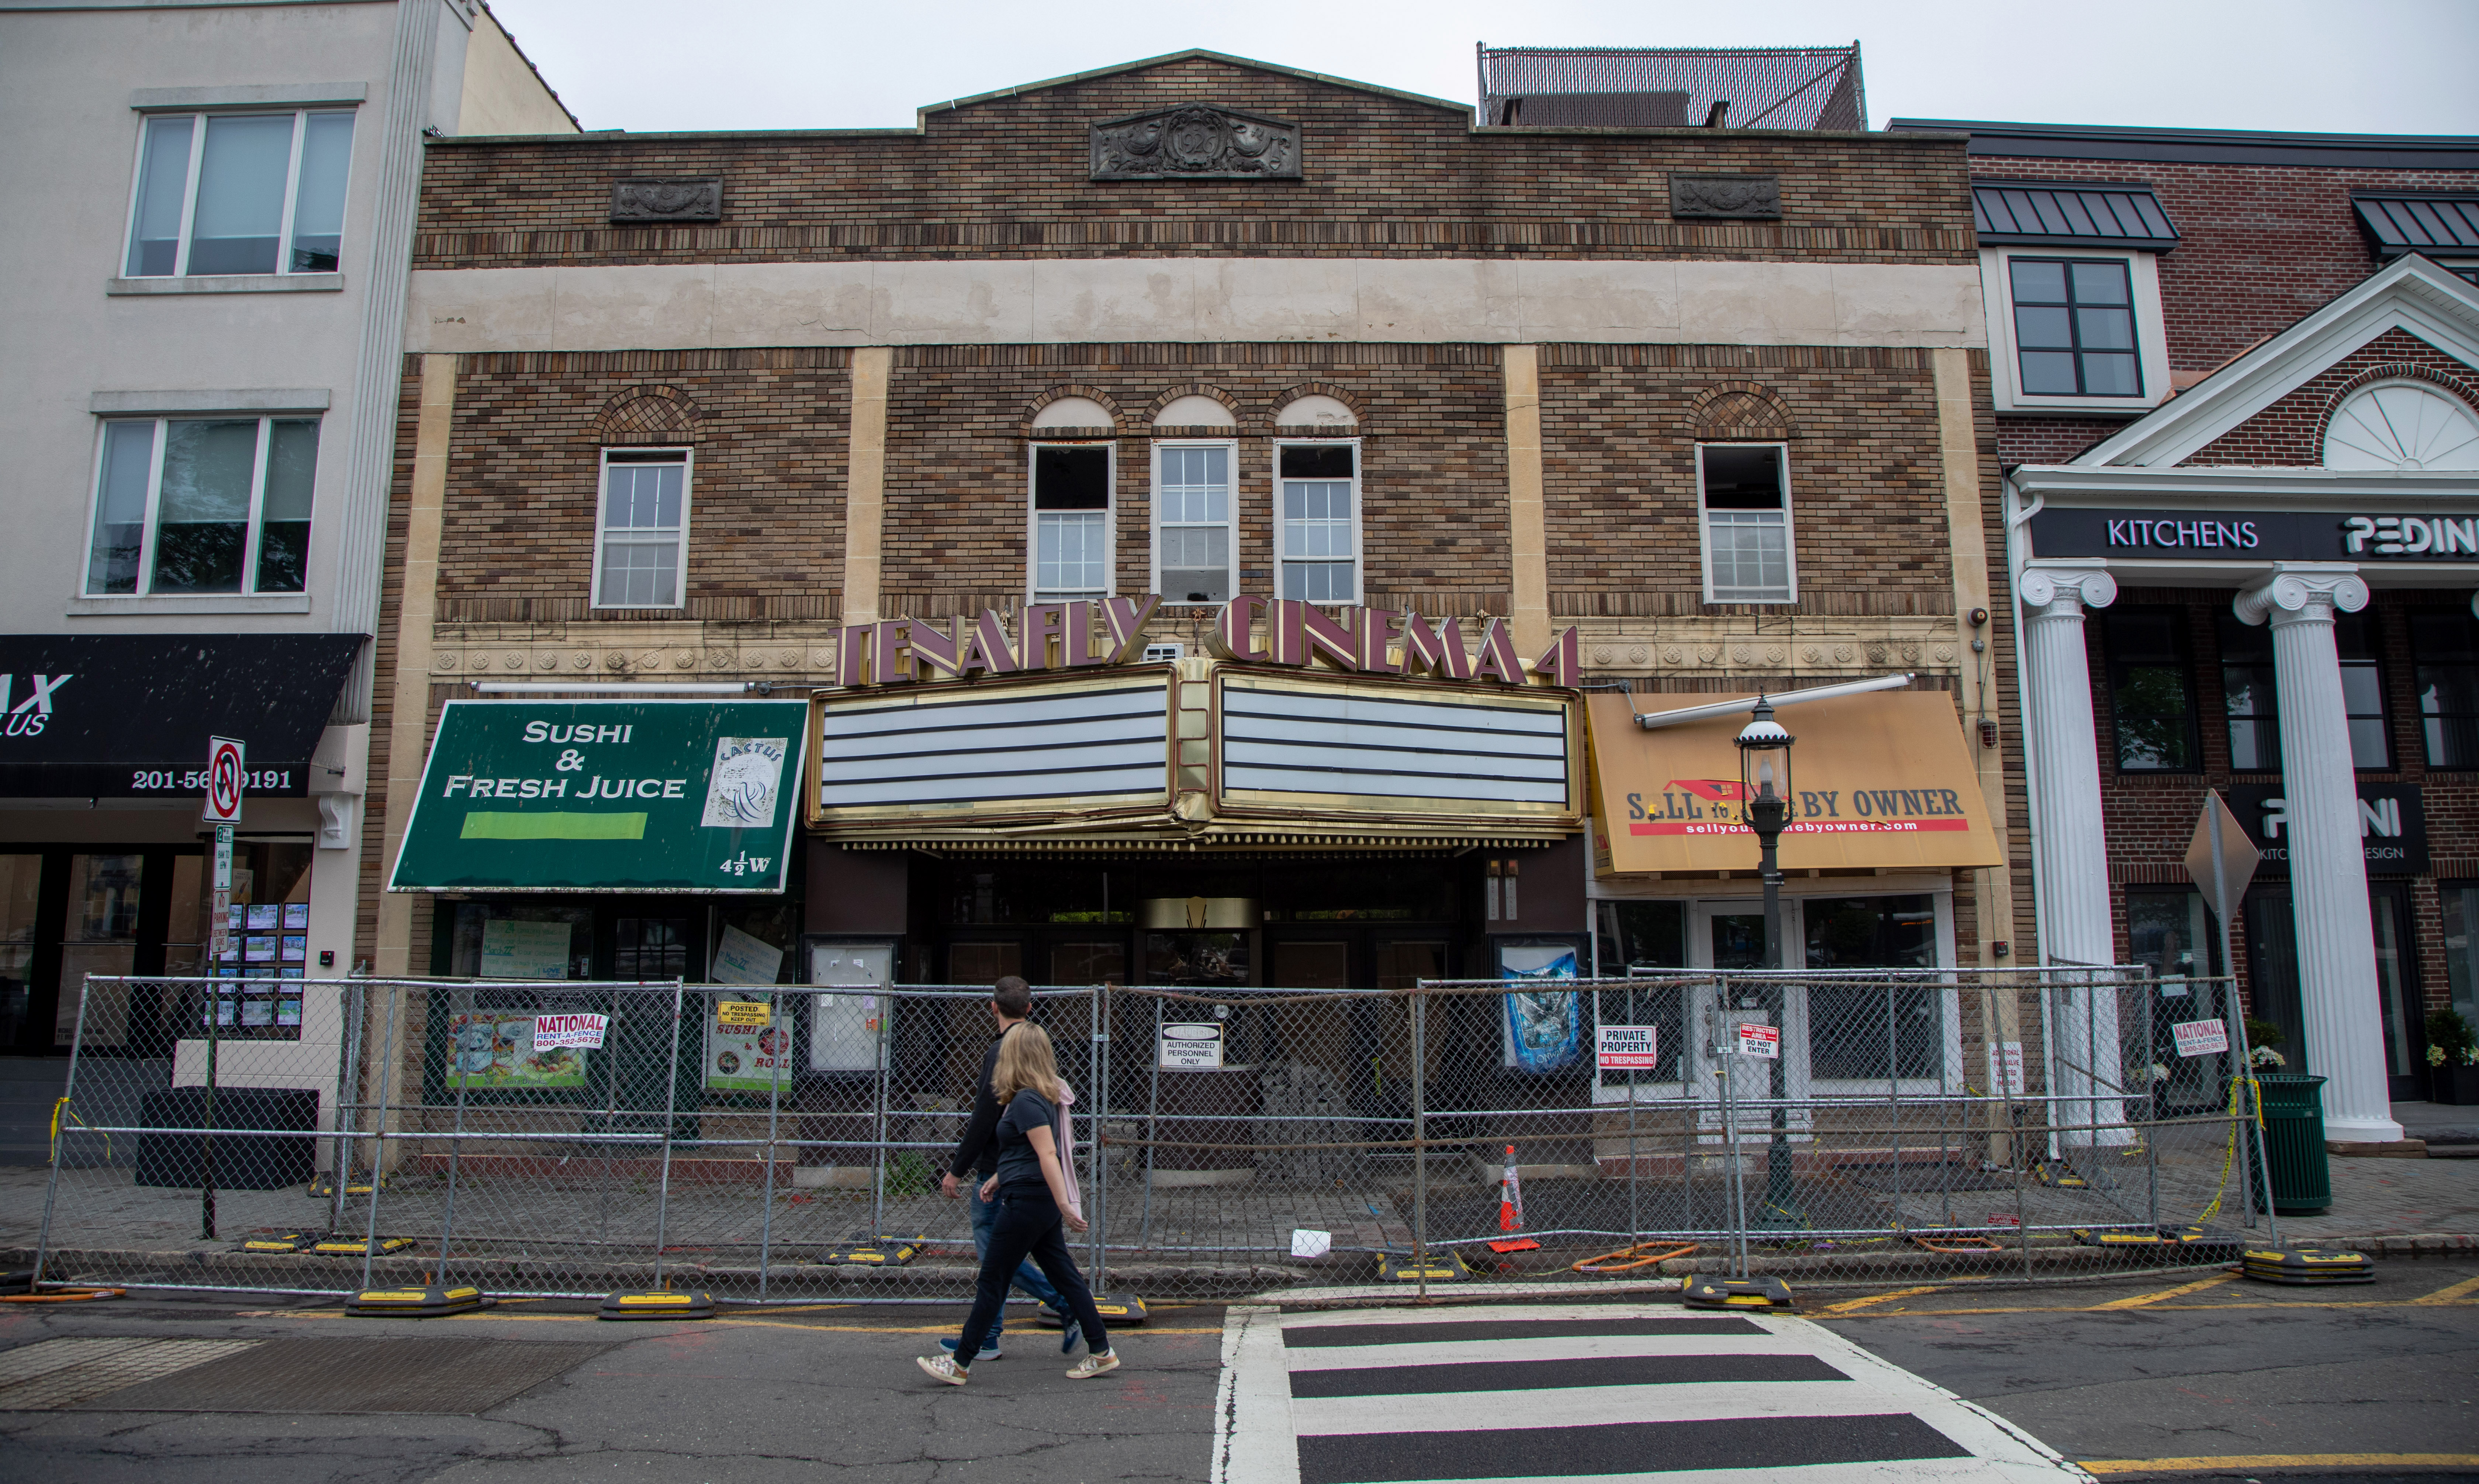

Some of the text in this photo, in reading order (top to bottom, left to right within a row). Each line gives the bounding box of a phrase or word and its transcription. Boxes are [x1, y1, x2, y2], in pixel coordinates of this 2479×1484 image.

[1178, 131, 1217, 153] 1926
[2107, 519, 2259, 548] KITCHENS
[2345, 517, 2479, 553] PEDIN
[827, 594, 1583, 687] TENAFLY CINEMA 4
[720, 742, 782, 762] CACTUS
[556, 749, 584, 771] &
[132, 771, 291, 788] 201-569191
[1799, 791, 1839, 817] BY
[1853, 789, 1964, 816] OWNER
[2261, 798, 2403, 838] PNI
[218, 829, 223, 841] 2
[226, 850, 230, 859] TO
[2365, 847, 2404, 859] ESIGN
[218, 897, 225, 908] NO
[214, 912, 228, 924] PARKING
[214, 929, 227, 938] BETWEEN
[505, 922, 515, 934] 24
[216, 937, 224, 946] SIGNS
[483, 944, 504, 954] March
[725, 950, 739, 965] March
[537, 1015, 604, 1033] NATIONAL
[716, 1024, 758, 1035] SUSHI
[1742, 1025, 1776, 1035] RESTRICTED
[2174, 1020, 2223, 1040] NATIONAL
[537, 1031, 603, 1040] RENT-A-FENCE
[1173, 1028, 1209, 1037] DANGER
[1606, 1030, 1646, 1041] PRIVATE
[536, 1036, 601, 1047] 800-352-5675
[744, 1042, 752, 1050] &
[1601, 1041, 1652, 1052] PROPERTY
[2178, 1036, 2224, 1047] RENT-A-FENCE
[2179, 1041, 2226, 1053] 1-800-352-5675
[1747, 1046, 1770, 1054] ENTER
[754, 1057, 790, 1069] ROL
[1600, 1056, 1654, 1065] NO TRESPASSING
